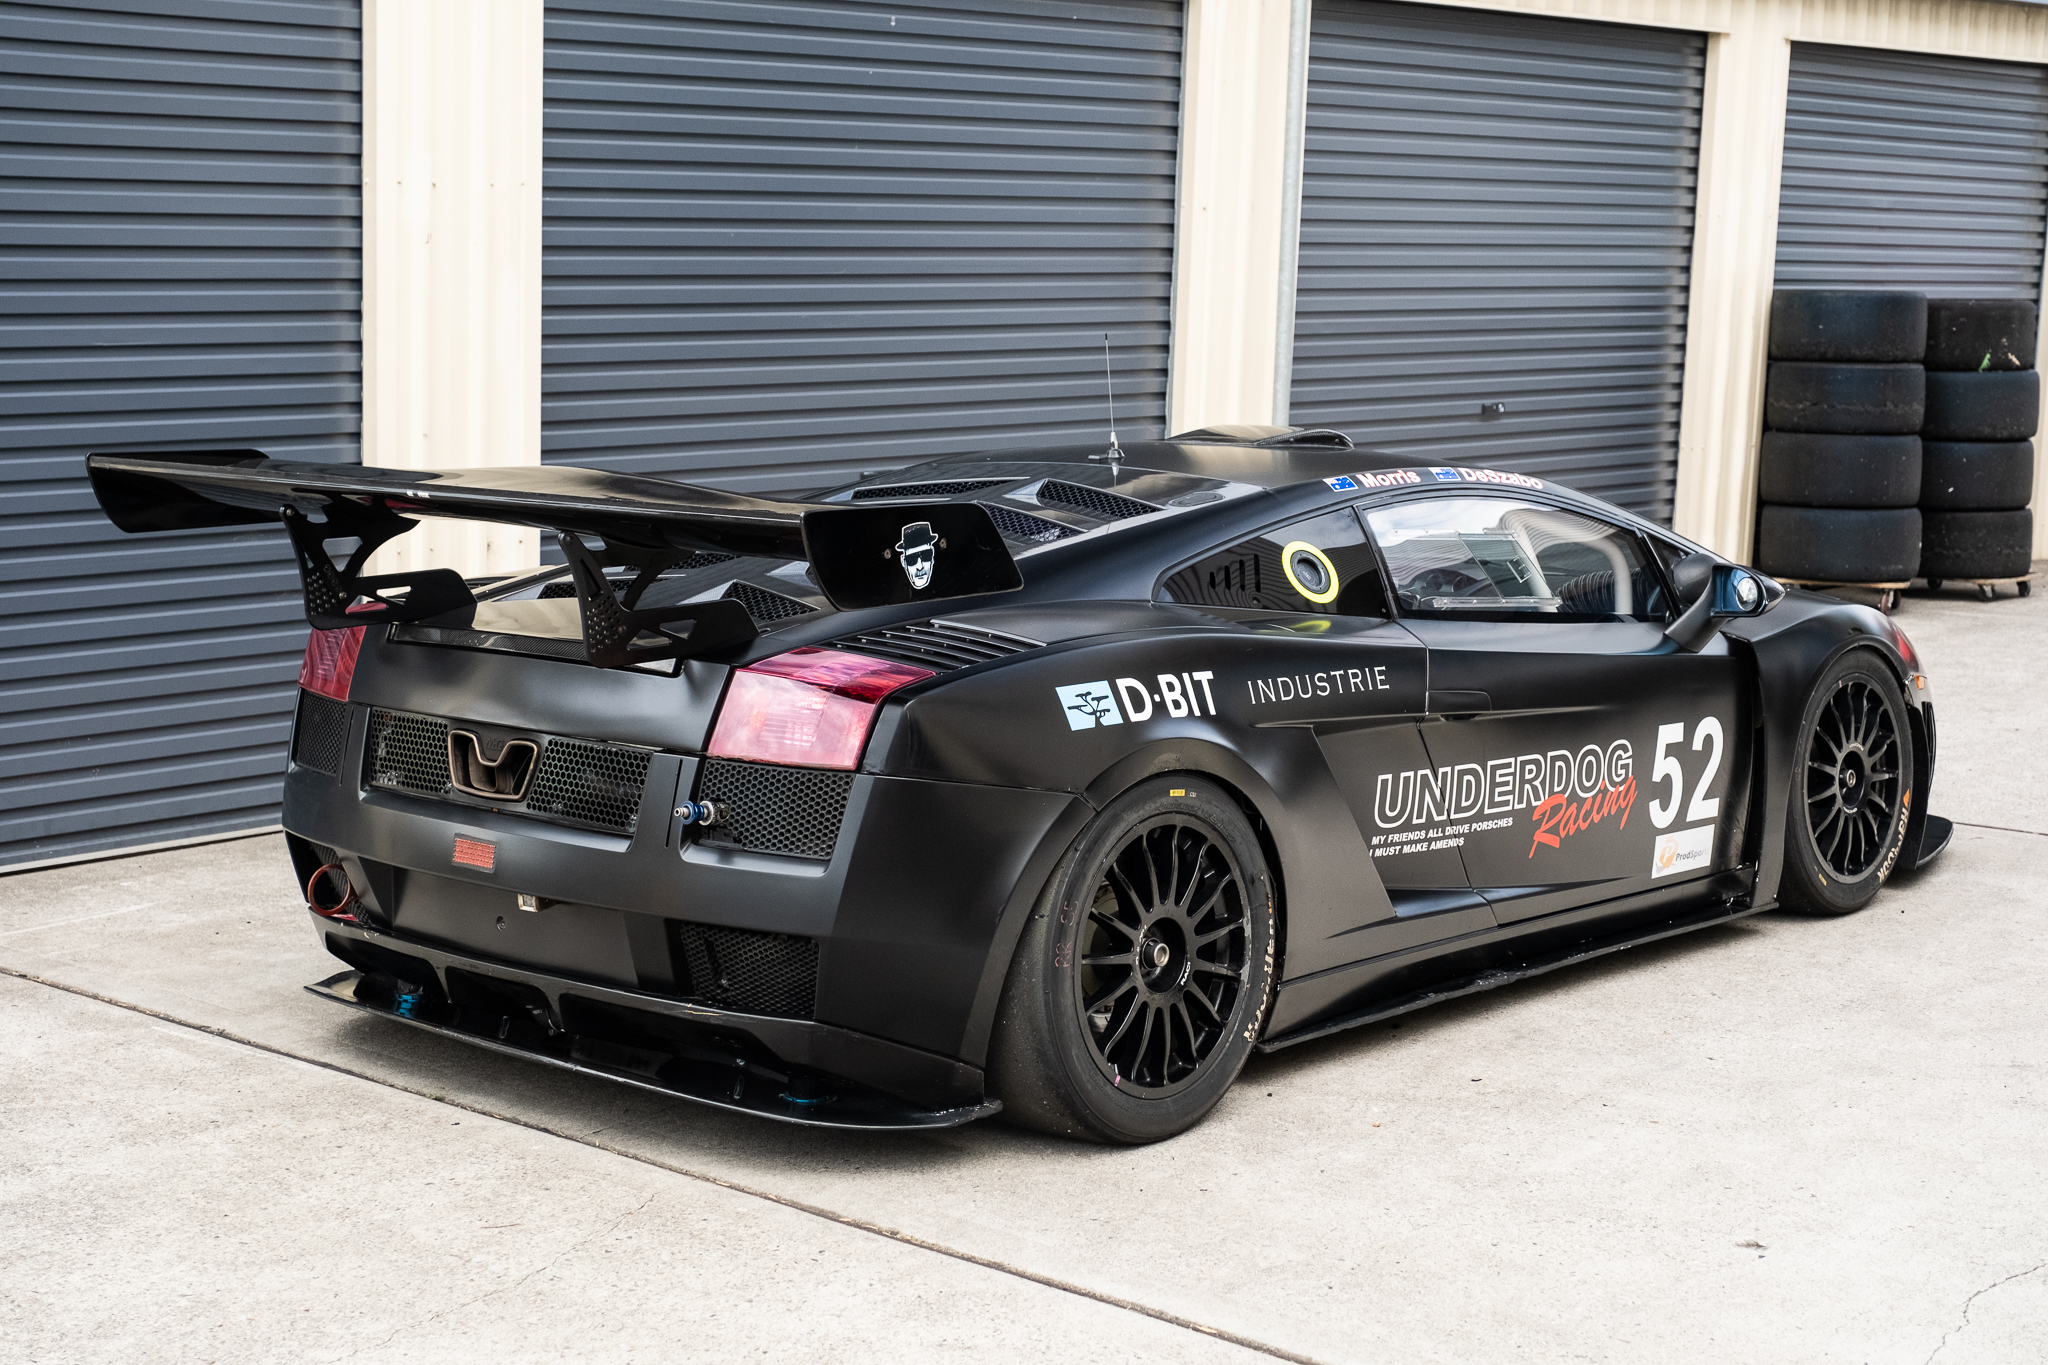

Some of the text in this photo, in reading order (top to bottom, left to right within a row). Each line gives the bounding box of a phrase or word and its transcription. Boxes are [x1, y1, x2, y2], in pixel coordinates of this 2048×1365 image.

[1355, 469, 1421, 488] Morris
[1456, 467, 1544, 490] DeSzabo
[1247, 665, 1390, 705] INDUSTRIE
[1373, 739, 1633, 829] UNDERDOG
[1648, 716, 1725, 829] 52
[1371, 817, 1514, 846] MY FRIENDS ALL DRIVE PORSCHES
[1528, 774, 1638, 859] Racing
[1374, 845, 1401, 858] MUST
[1402, 841, 1429, 854] MAKE
[1429, 837, 1465, 851] AMENDS
